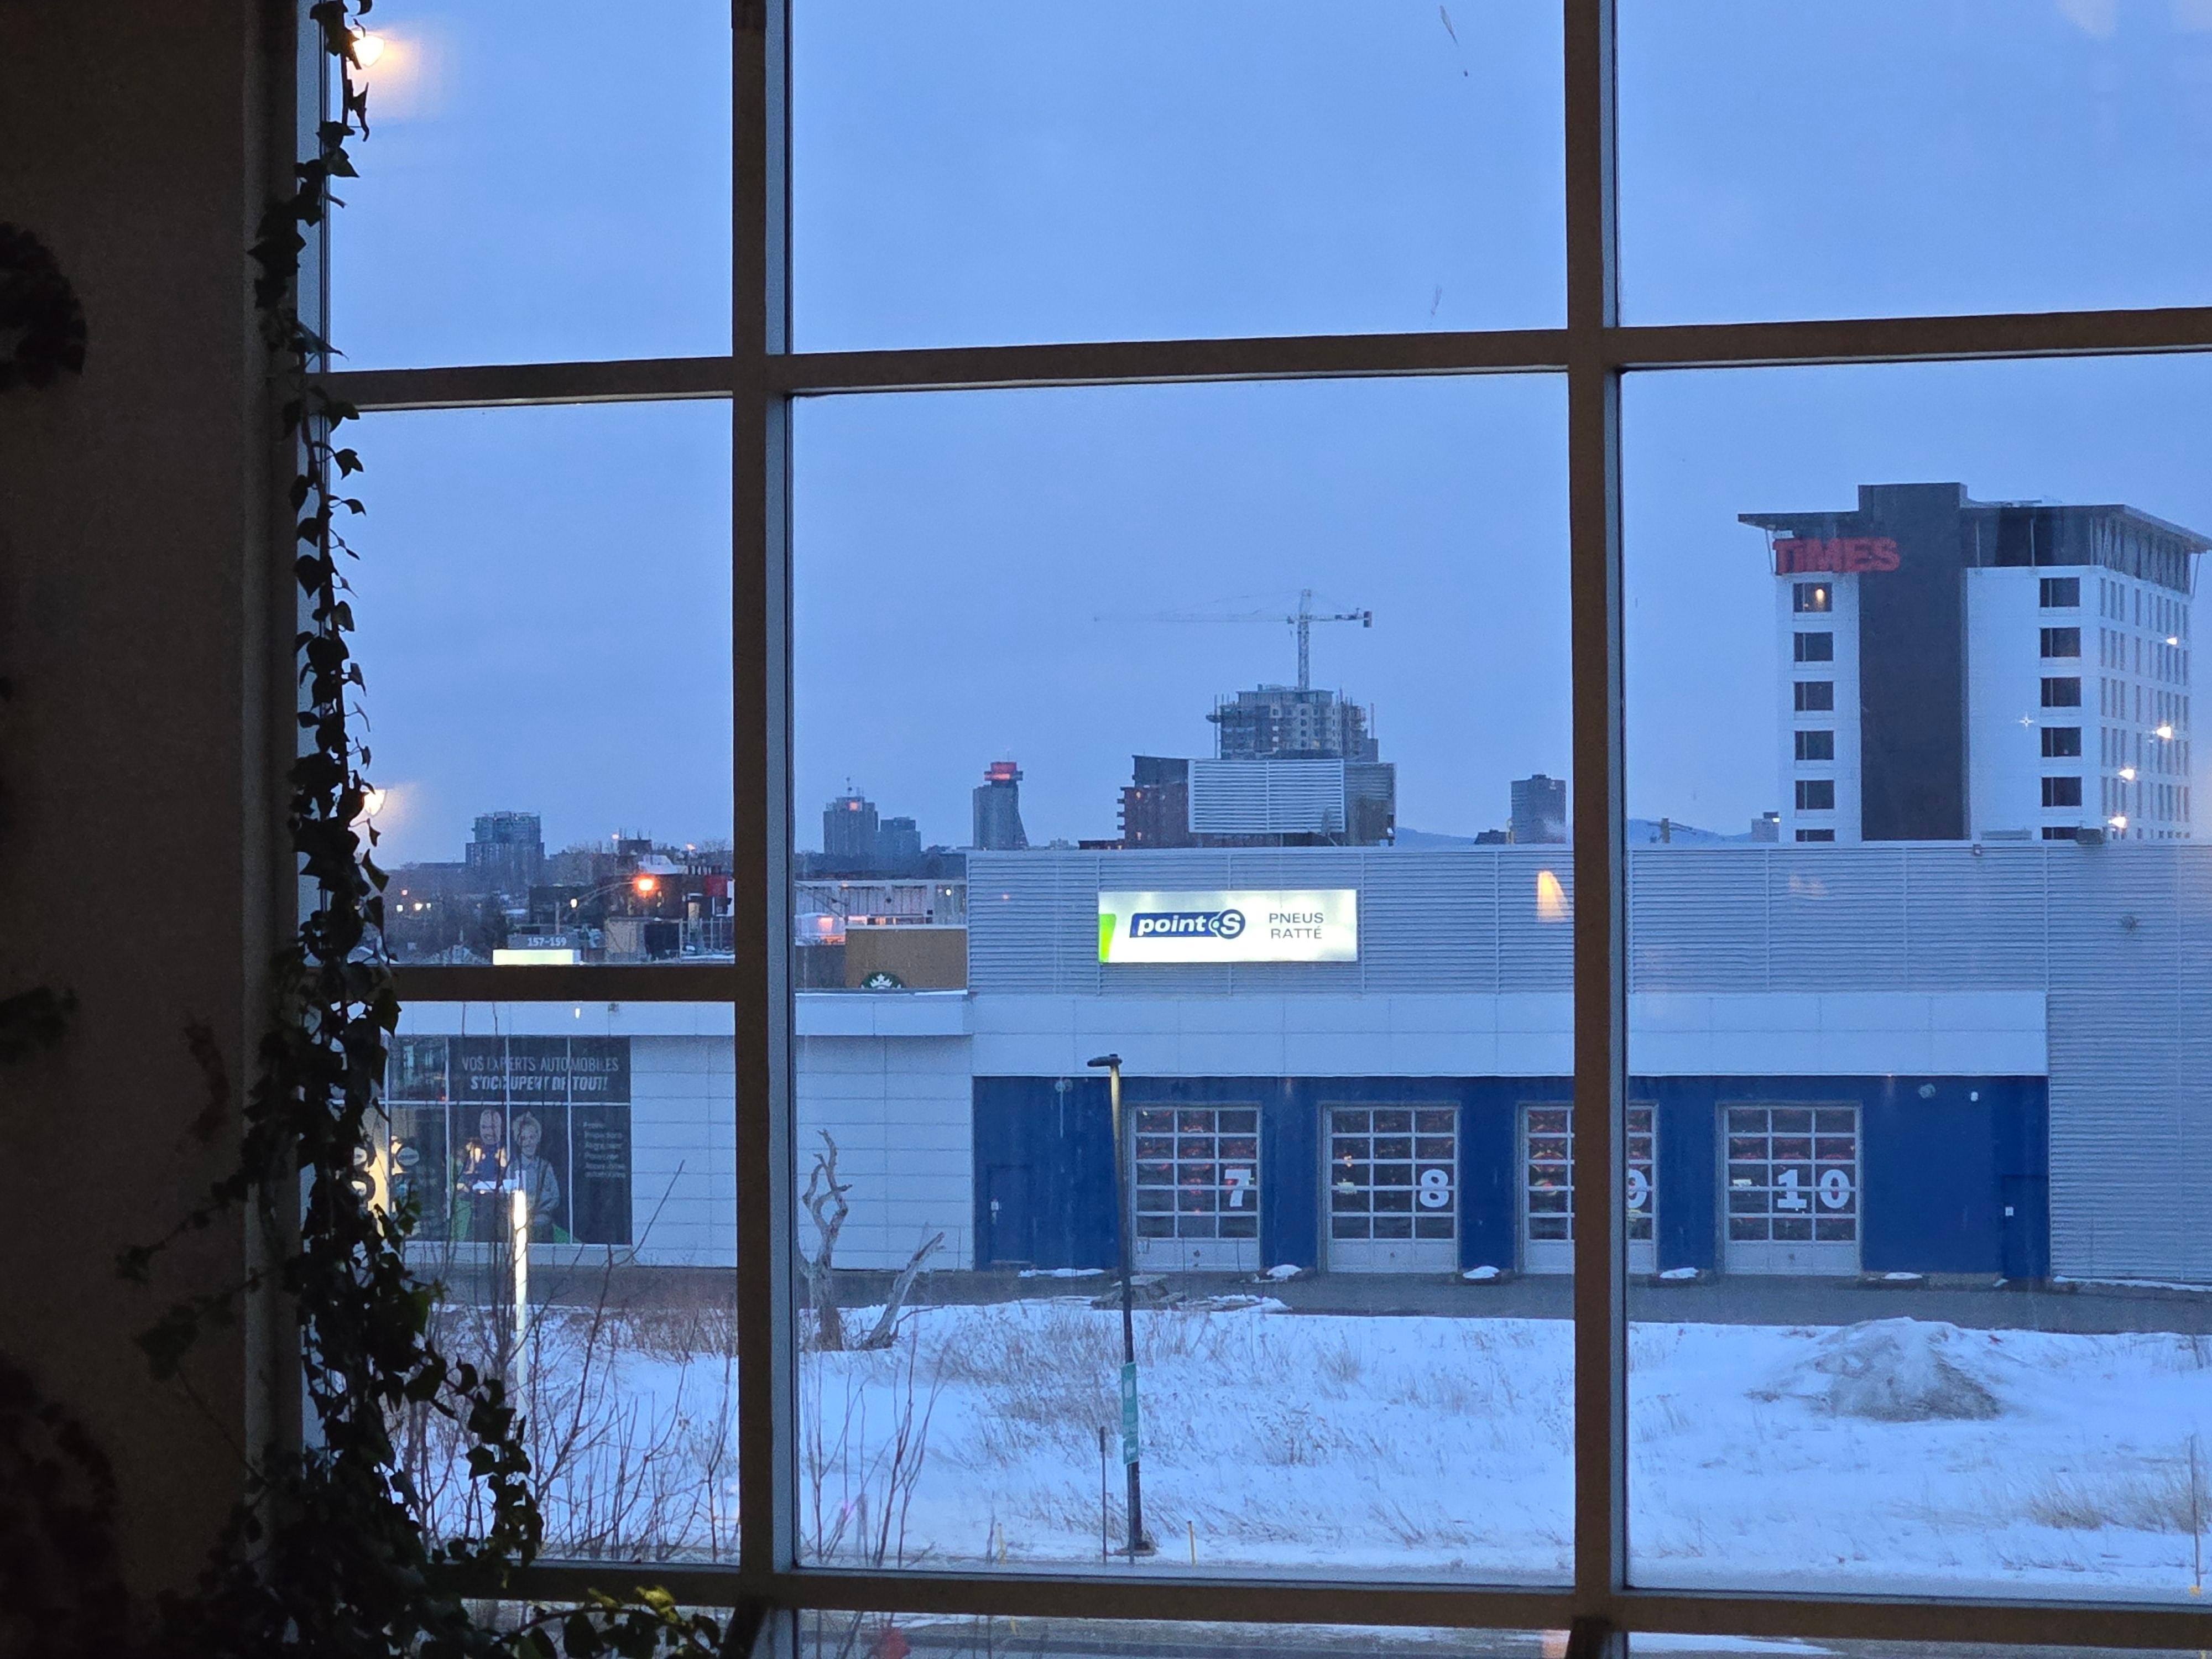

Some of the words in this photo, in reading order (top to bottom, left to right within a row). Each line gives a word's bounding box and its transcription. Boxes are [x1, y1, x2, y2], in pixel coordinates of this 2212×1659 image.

[1773, 538, 1901, 574] TIMES
[1138, 915, 1207, 936] point
[1269, 912, 1324, 924] PNEUS
[528, 936, 567, 947] 157-159
[1271, 926, 1322, 939] RATTÉ
[462, 1056, 484, 1072] VOS
[540, 1056, 619, 1072] AUTOMOBILES
[572, 1076, 608, 1091] TOUT!
[1224, 1168, 1252, 1207] 7
[1420, 1168, 1450, 1208] 8
[1777, 1168, 1850, 1209] 10
